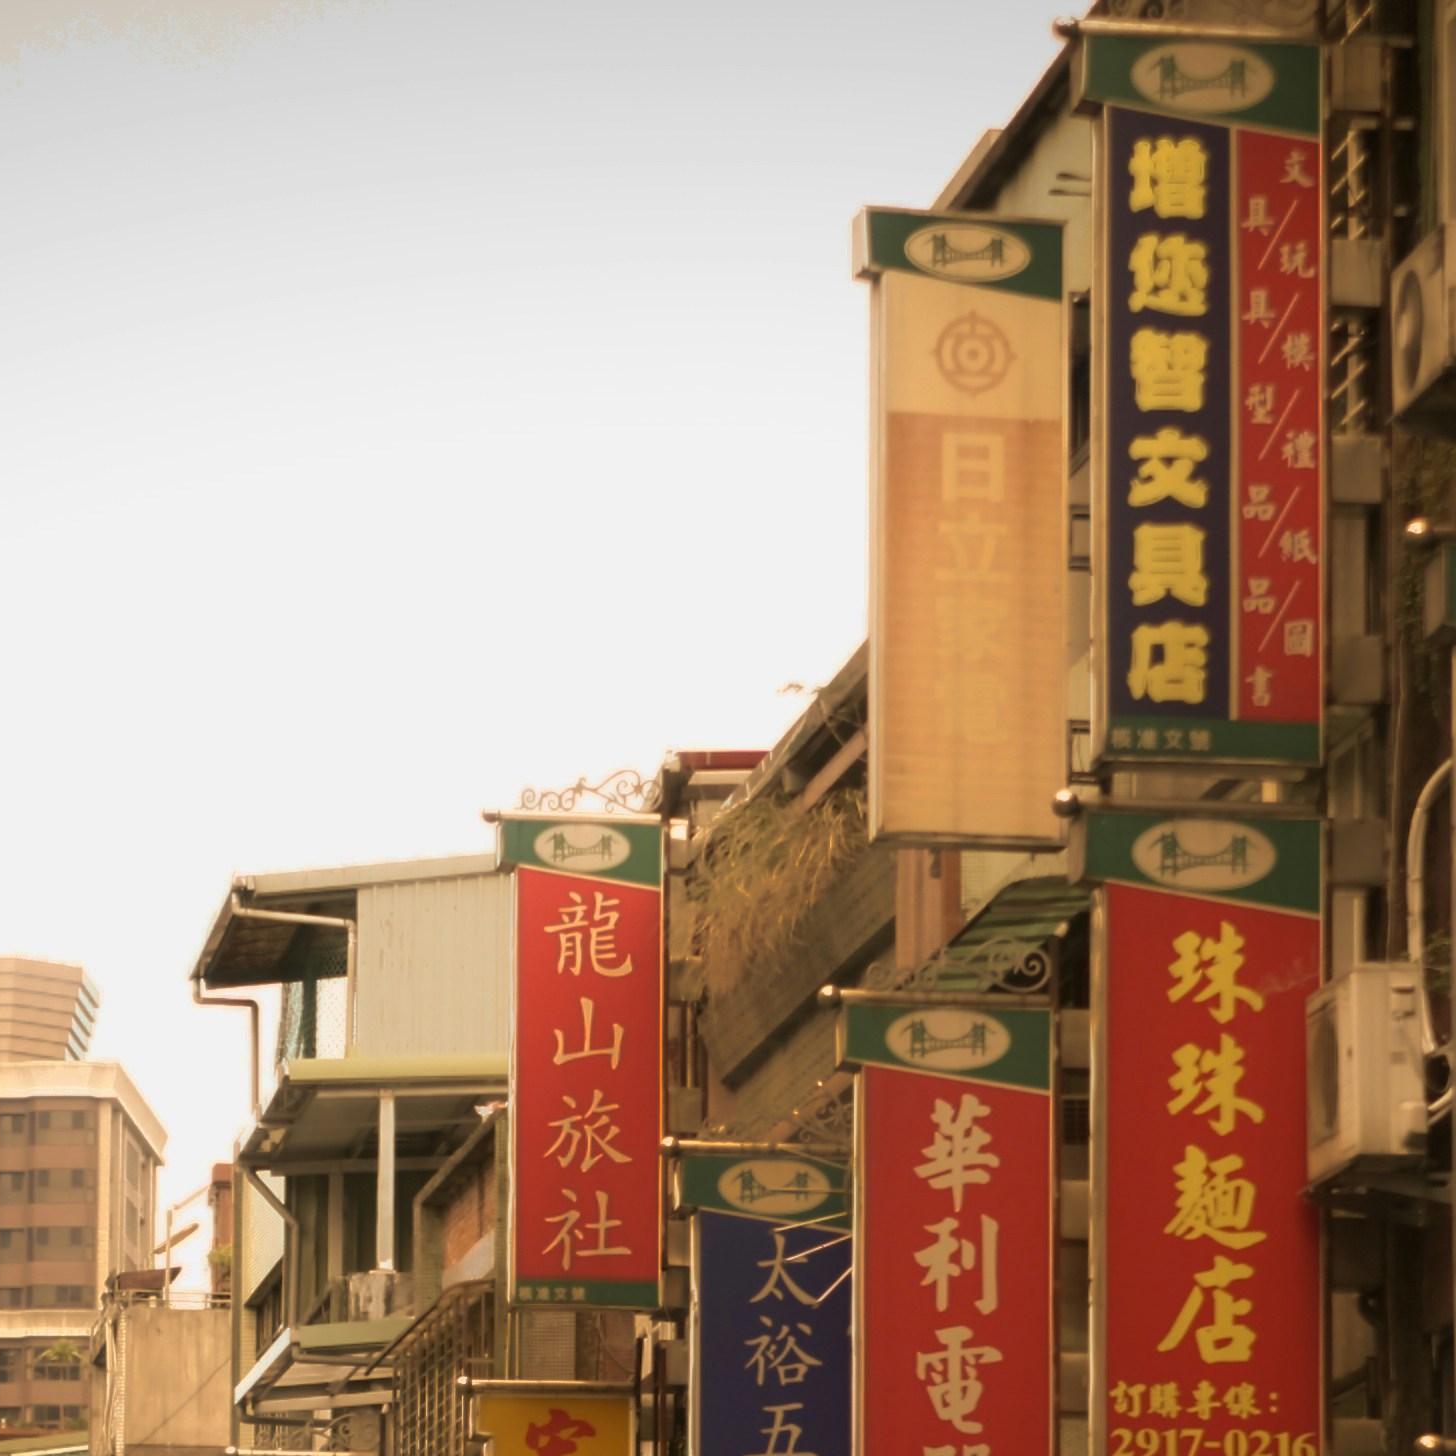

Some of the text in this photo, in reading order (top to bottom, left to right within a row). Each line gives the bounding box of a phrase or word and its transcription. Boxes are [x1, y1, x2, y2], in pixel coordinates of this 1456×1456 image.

[544, 890, 633, 1271] 龍山旅社
[1156, 920, 1267, 1365] 珠珠麵店
